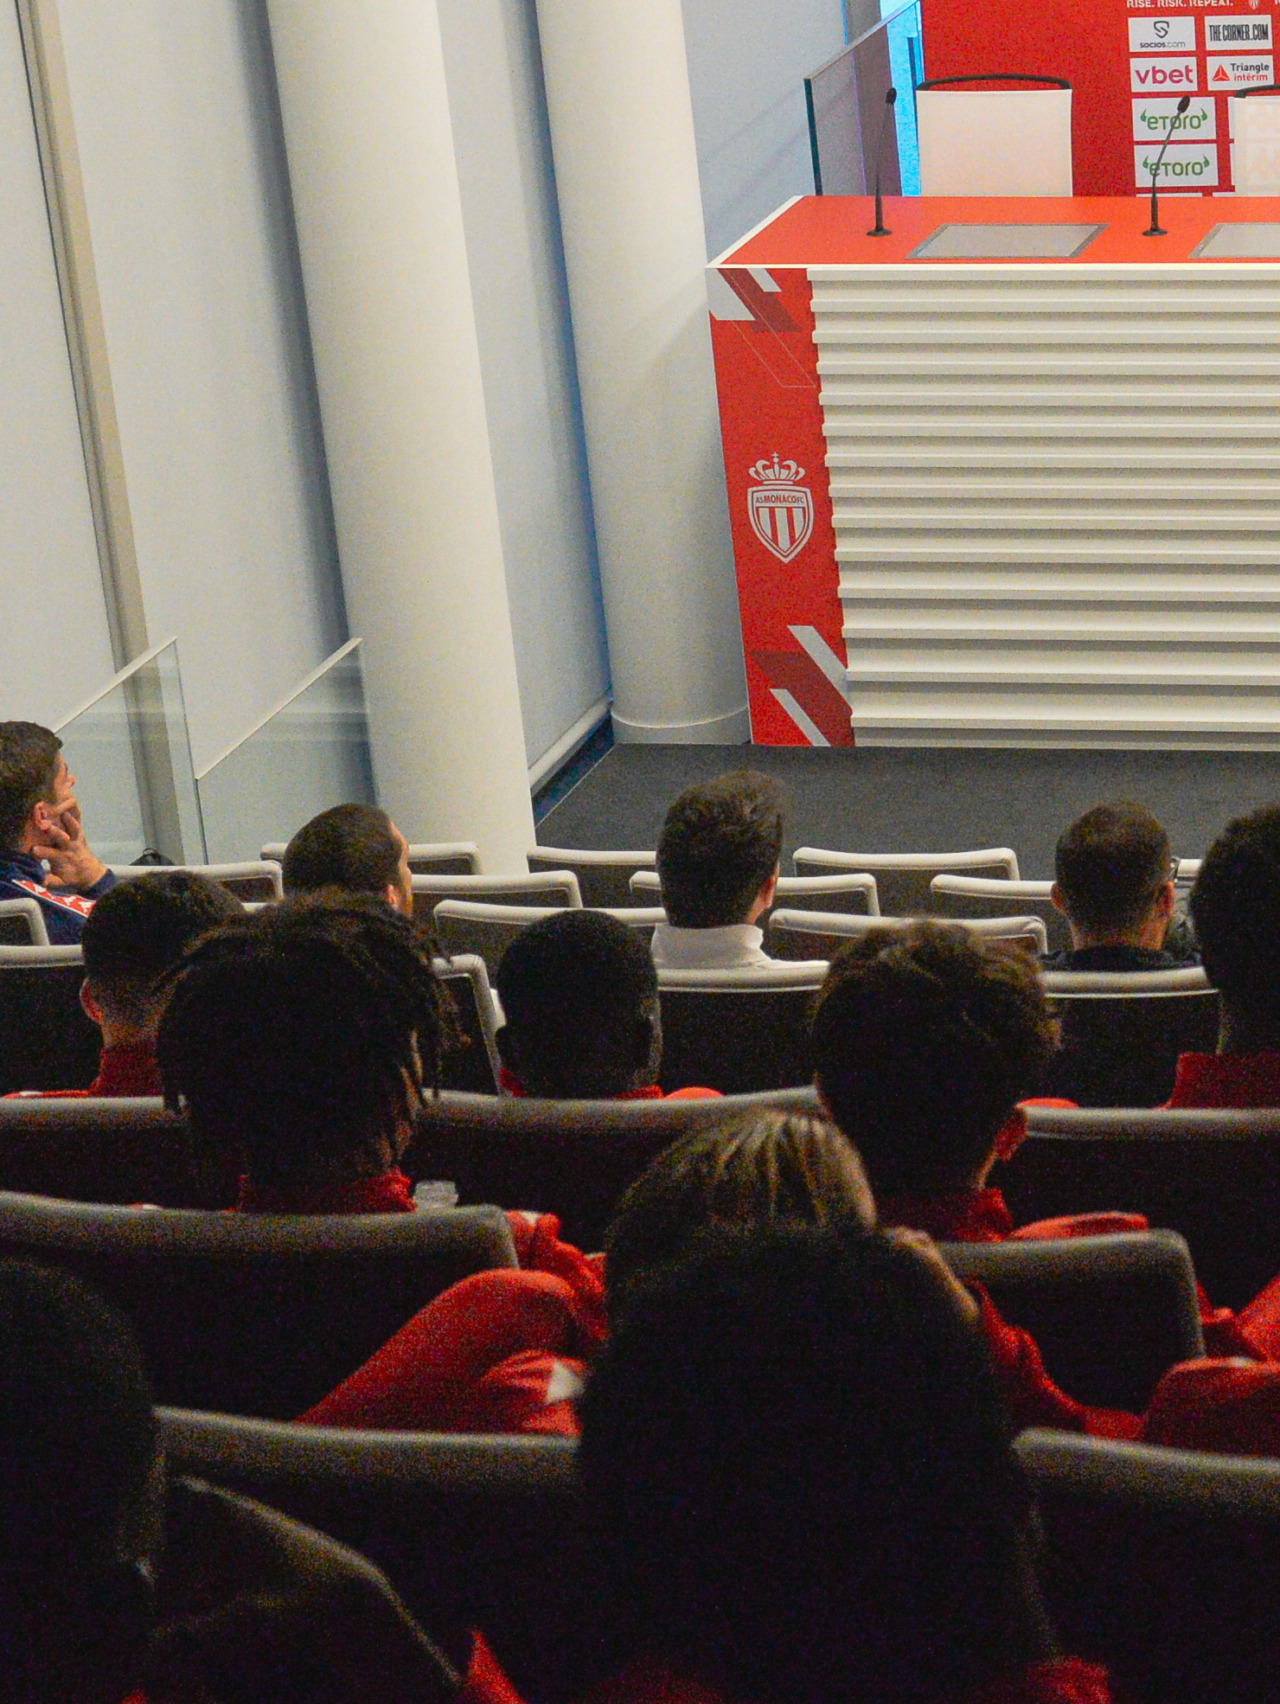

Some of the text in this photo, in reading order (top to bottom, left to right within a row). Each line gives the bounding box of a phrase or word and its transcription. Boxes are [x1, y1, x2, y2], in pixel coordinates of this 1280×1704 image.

[1209, 25, 1221, 42] THE
[1135, 65, 1193, 84] vbet
[1230, 63, 1269, 73] Triangle
[1234, 72, 1268, 81] intérim
